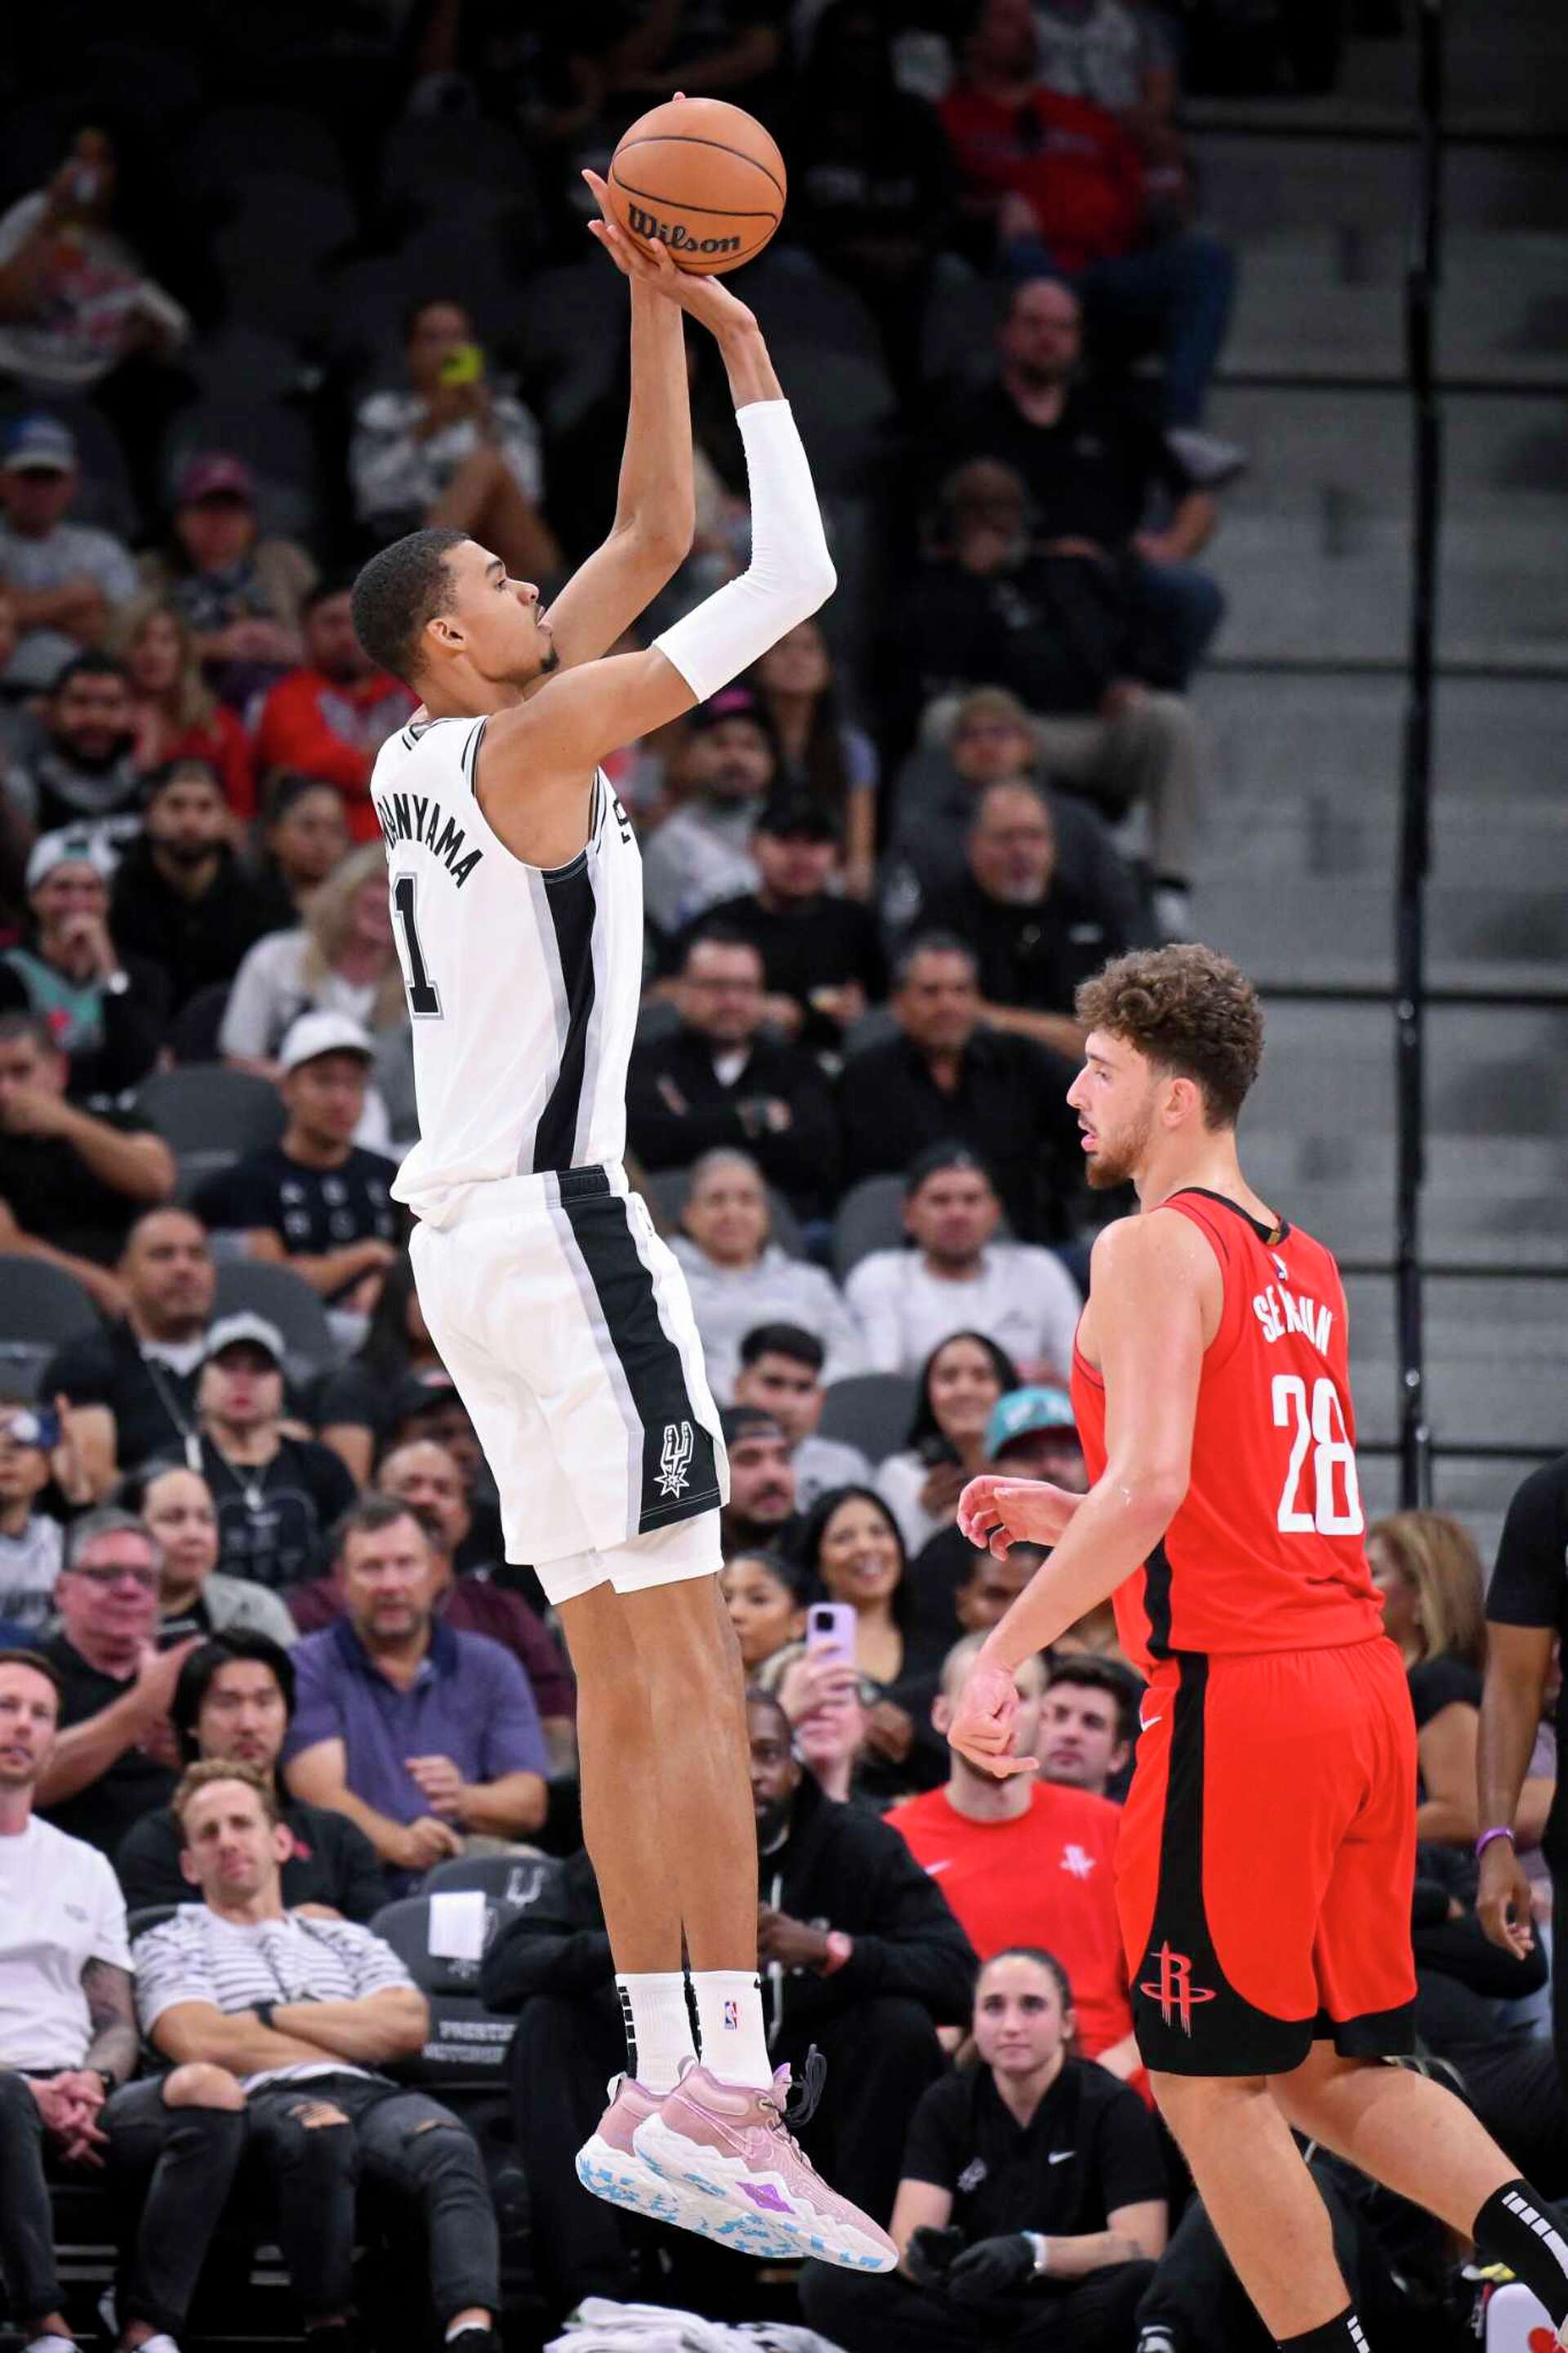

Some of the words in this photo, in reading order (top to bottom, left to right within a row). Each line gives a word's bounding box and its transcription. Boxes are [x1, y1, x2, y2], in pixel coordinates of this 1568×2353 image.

[628, 202, 742, 254] Wilson
[393, 871, 443, 1020] 1
[1271, 1374, 1365, 1536] 28
